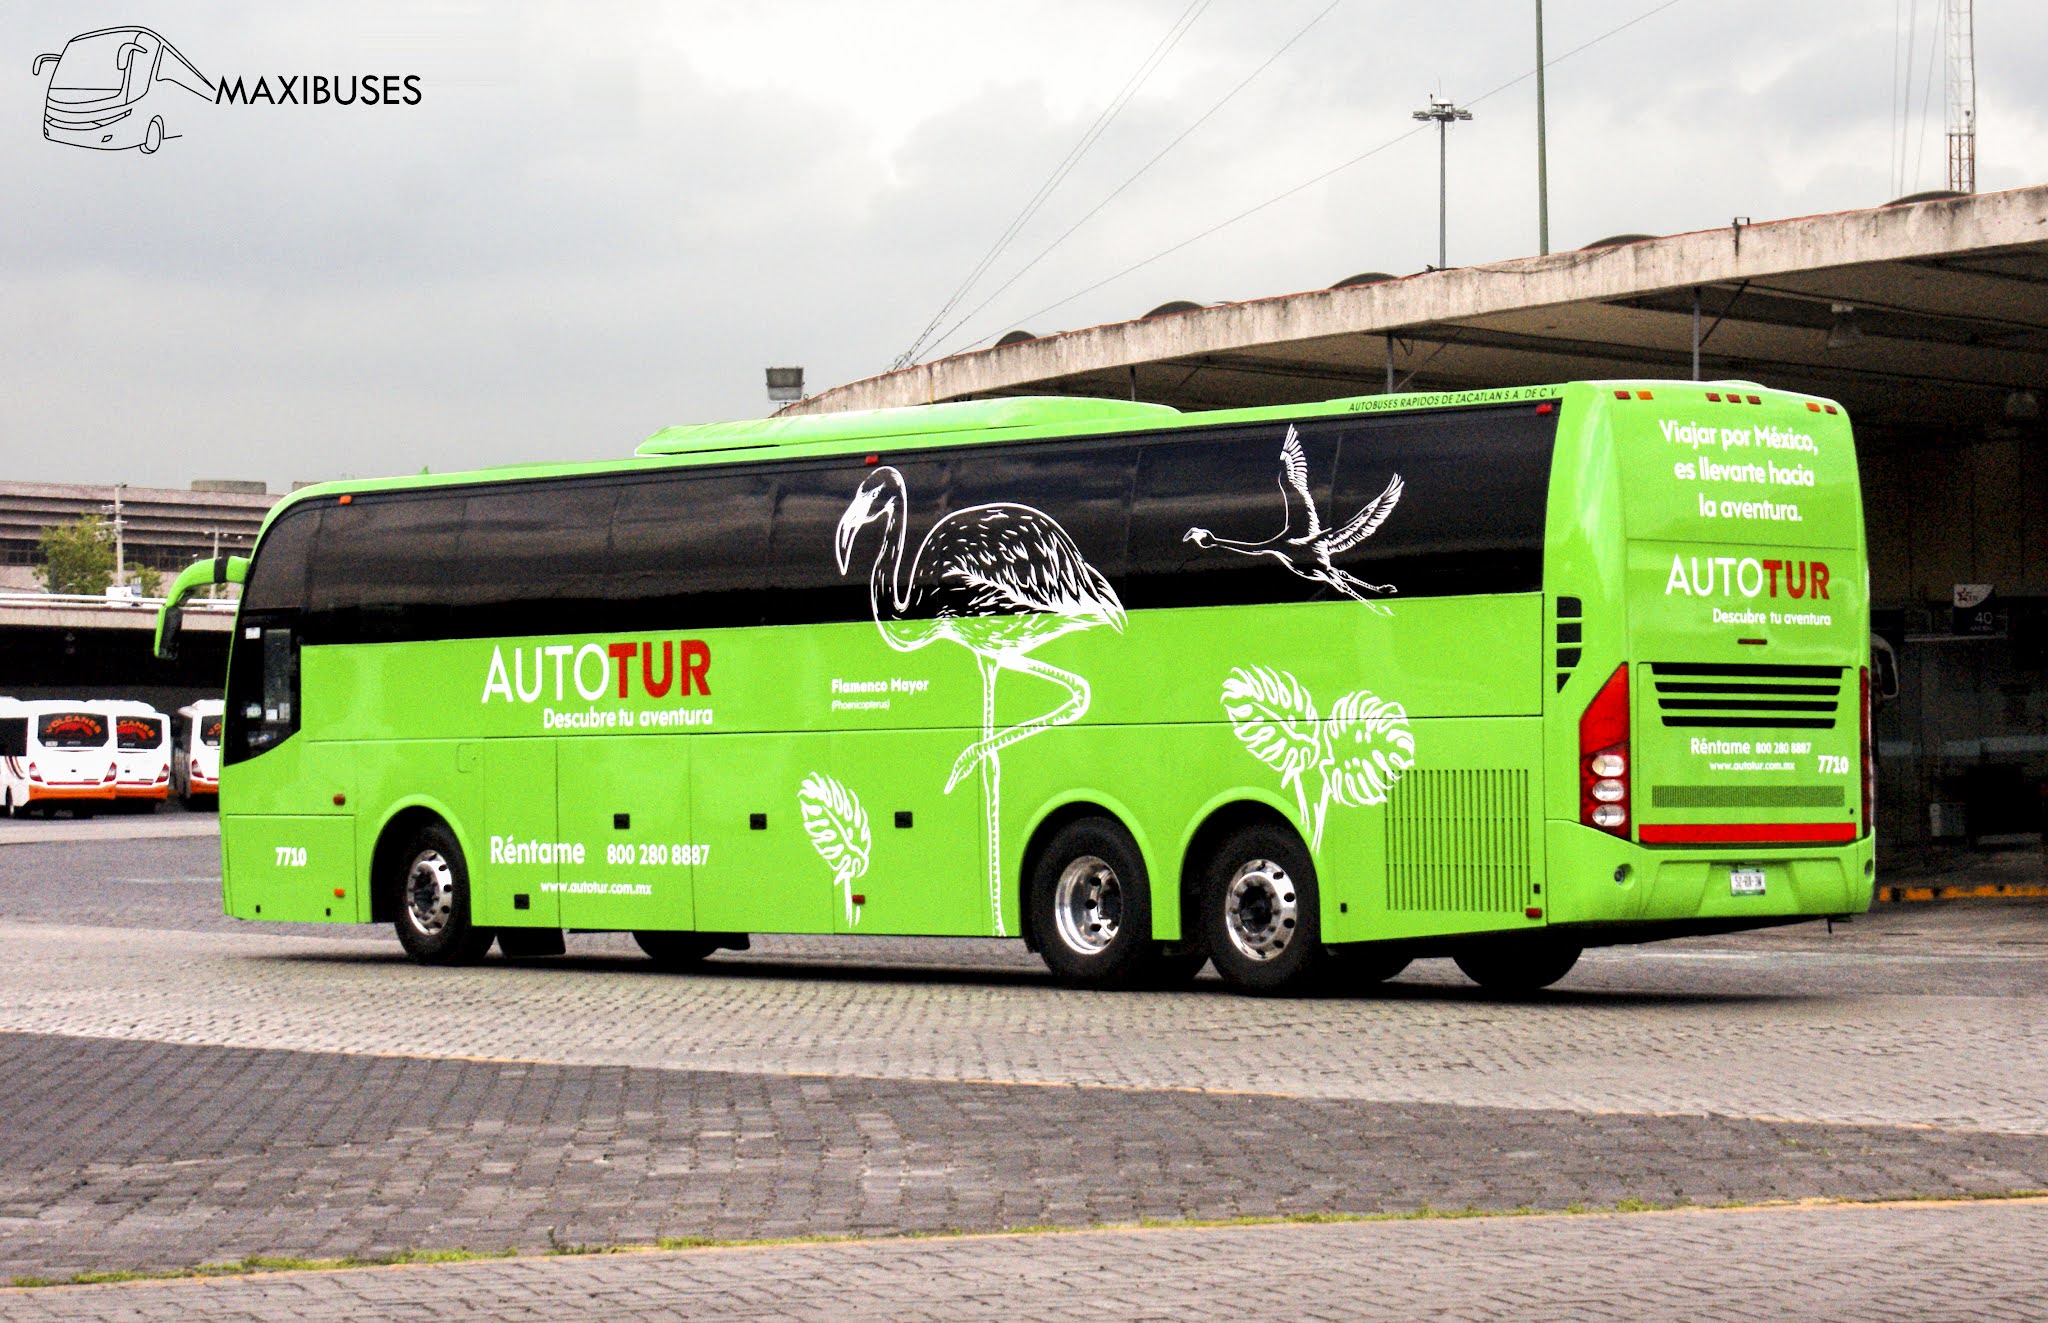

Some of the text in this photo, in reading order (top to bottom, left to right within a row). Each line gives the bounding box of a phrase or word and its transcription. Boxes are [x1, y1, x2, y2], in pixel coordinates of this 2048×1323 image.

[1348, 399, 1398, 412] AUTOBUSES
[1400, 396, 1440, 407] RAPIDOS
[1441, 394, 1453, 405] DE
[1455, 391, 1503, 404] ZACATLAN
[1524, 388, 1537, 399] DE
[1659, 418, 1819, 456] Viajar por México,
[1673, 455, 1815, 487] es llevarte hacia
[1698, 492, 1803, 522] la aventura.
[1664, 553, 1830, 600] AUTOTUR
[1712, 607, 1832, 626] Descubre tu aventura
[481, 639, 712, 704] AUTOTUR
[831, 676, 930, 696] Flamenco Mayor
[543, 705, 713, 729] Descubre tu aventura
[1690, 737, 1751, 755] Réntame
[1755, 742, 1772, 755] 800
[1773, 742, 1790, 755] 280
[1817, 754, 1850, 775] 7710
[275, 846, 308, 867] 7710
[490, 834, 711, 866] Réntame 800 280 8887
[540, 880, 652, 895] www.autotur.com.mx
